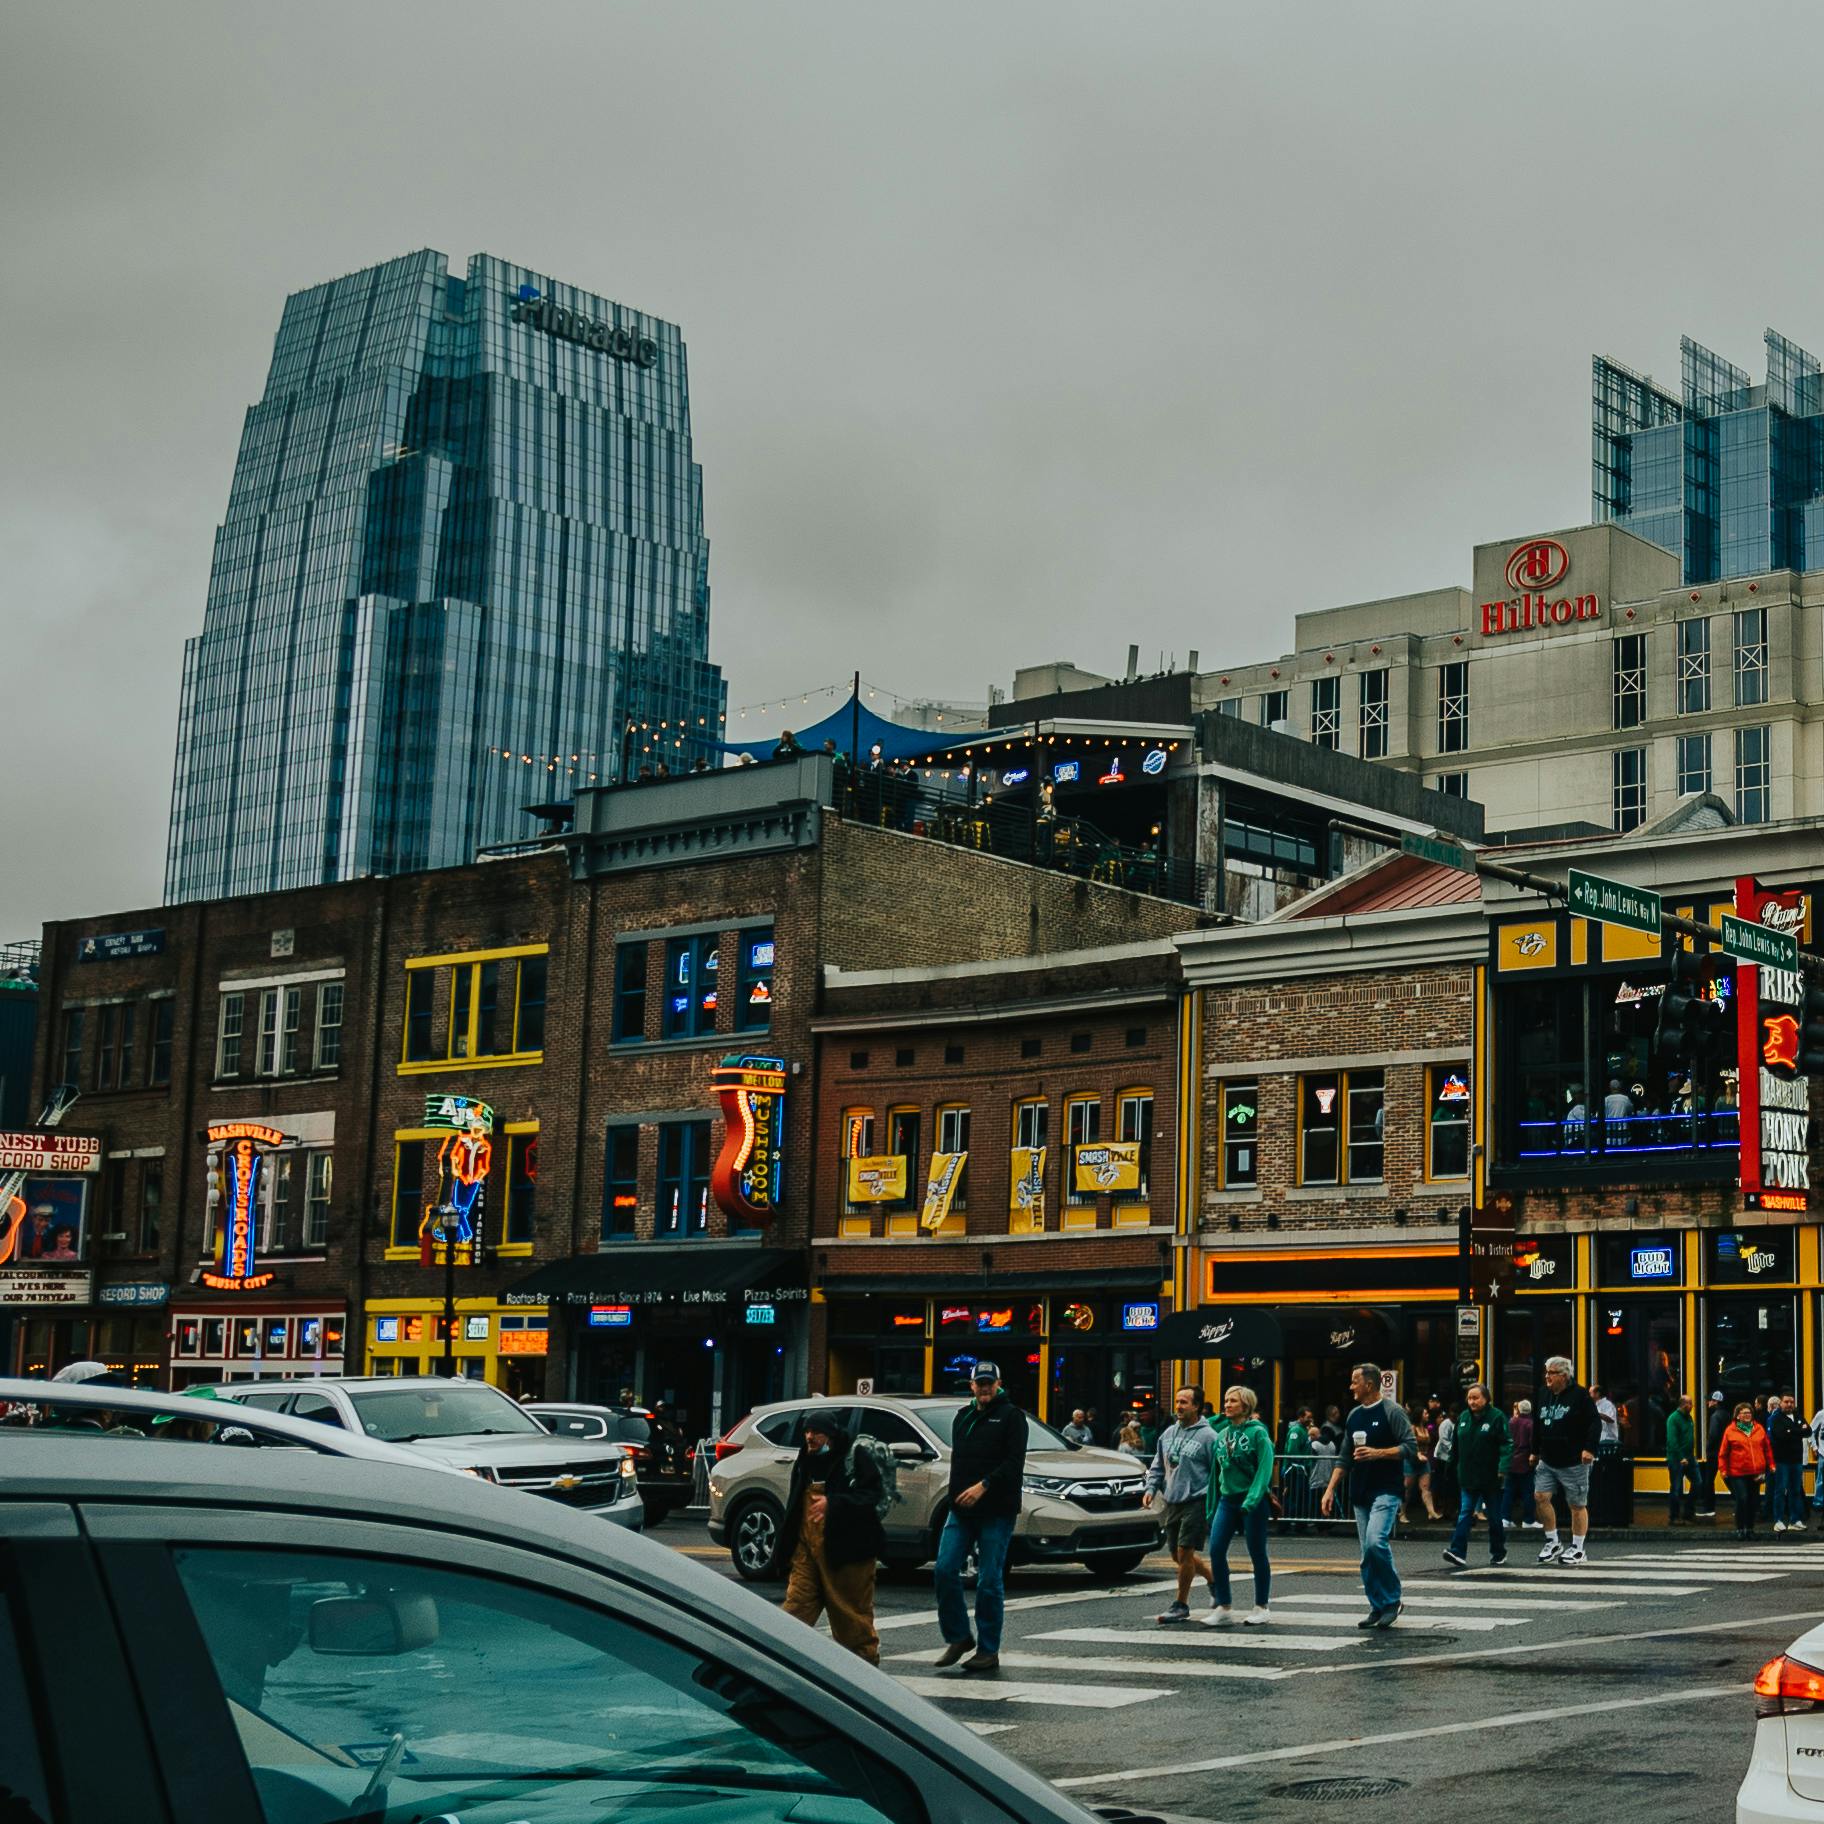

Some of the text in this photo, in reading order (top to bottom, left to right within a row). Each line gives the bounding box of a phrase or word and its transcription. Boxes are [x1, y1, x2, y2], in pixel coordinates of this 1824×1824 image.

[511, 284, 658, 370] Pinnacle
[1480, 592, 1602, 636] Hilton
[1584, 880, 1600, 911] Rep.
[1600, 884, 1617, 909] John
[1618, 888, 1638, 914] Lewis
[1651, 901, 1656, 924] N
[1725, 921, 1738, 950] Rep.
[1739, 925, 1753, 950] John
[1753, 930, 1770, 956] Lewis
[1780, 941, 1785, 962] S
[207, 1123, 283, 1146] NASHVILLE
[1761, 1111, 1809, 1153] HONKY
[54, 1135, 100, 1153] TUBB
[752, 1094, 772, 1204] MUSHROOM
[0, 1153, 91, 1170] CORD SHOP
[1762, 1151, 1809, 1190] TONK
[232, 1139, 252, 1277] CROSSROADS
[1760, 1194, 1807, 1211] NASHVILLE
[1474, 1243, 1513, 1256] The District
[1637, 1251, 1666, 1264] BUD
[1633, 1262, 1670, 1275] LIGHT
[100, 1286, 166, 1302] RECORD SHOP
[506, 1292, 536, 1305] Rooftop
[537, 1292, 551, 1304] Bar
[567, 1292, 587, 1304] Pizza
[619, 1290, 641, 1304] Since
[683, 1289, 700, 1303] Live
[702, 1289, 727, 1302] Music
[744, 1287, 808, 1302] Pizza Spirits
[745, 1308, 775, 1324] SELTZER
[1198, 1317, 1234, 1338] Rippy's
